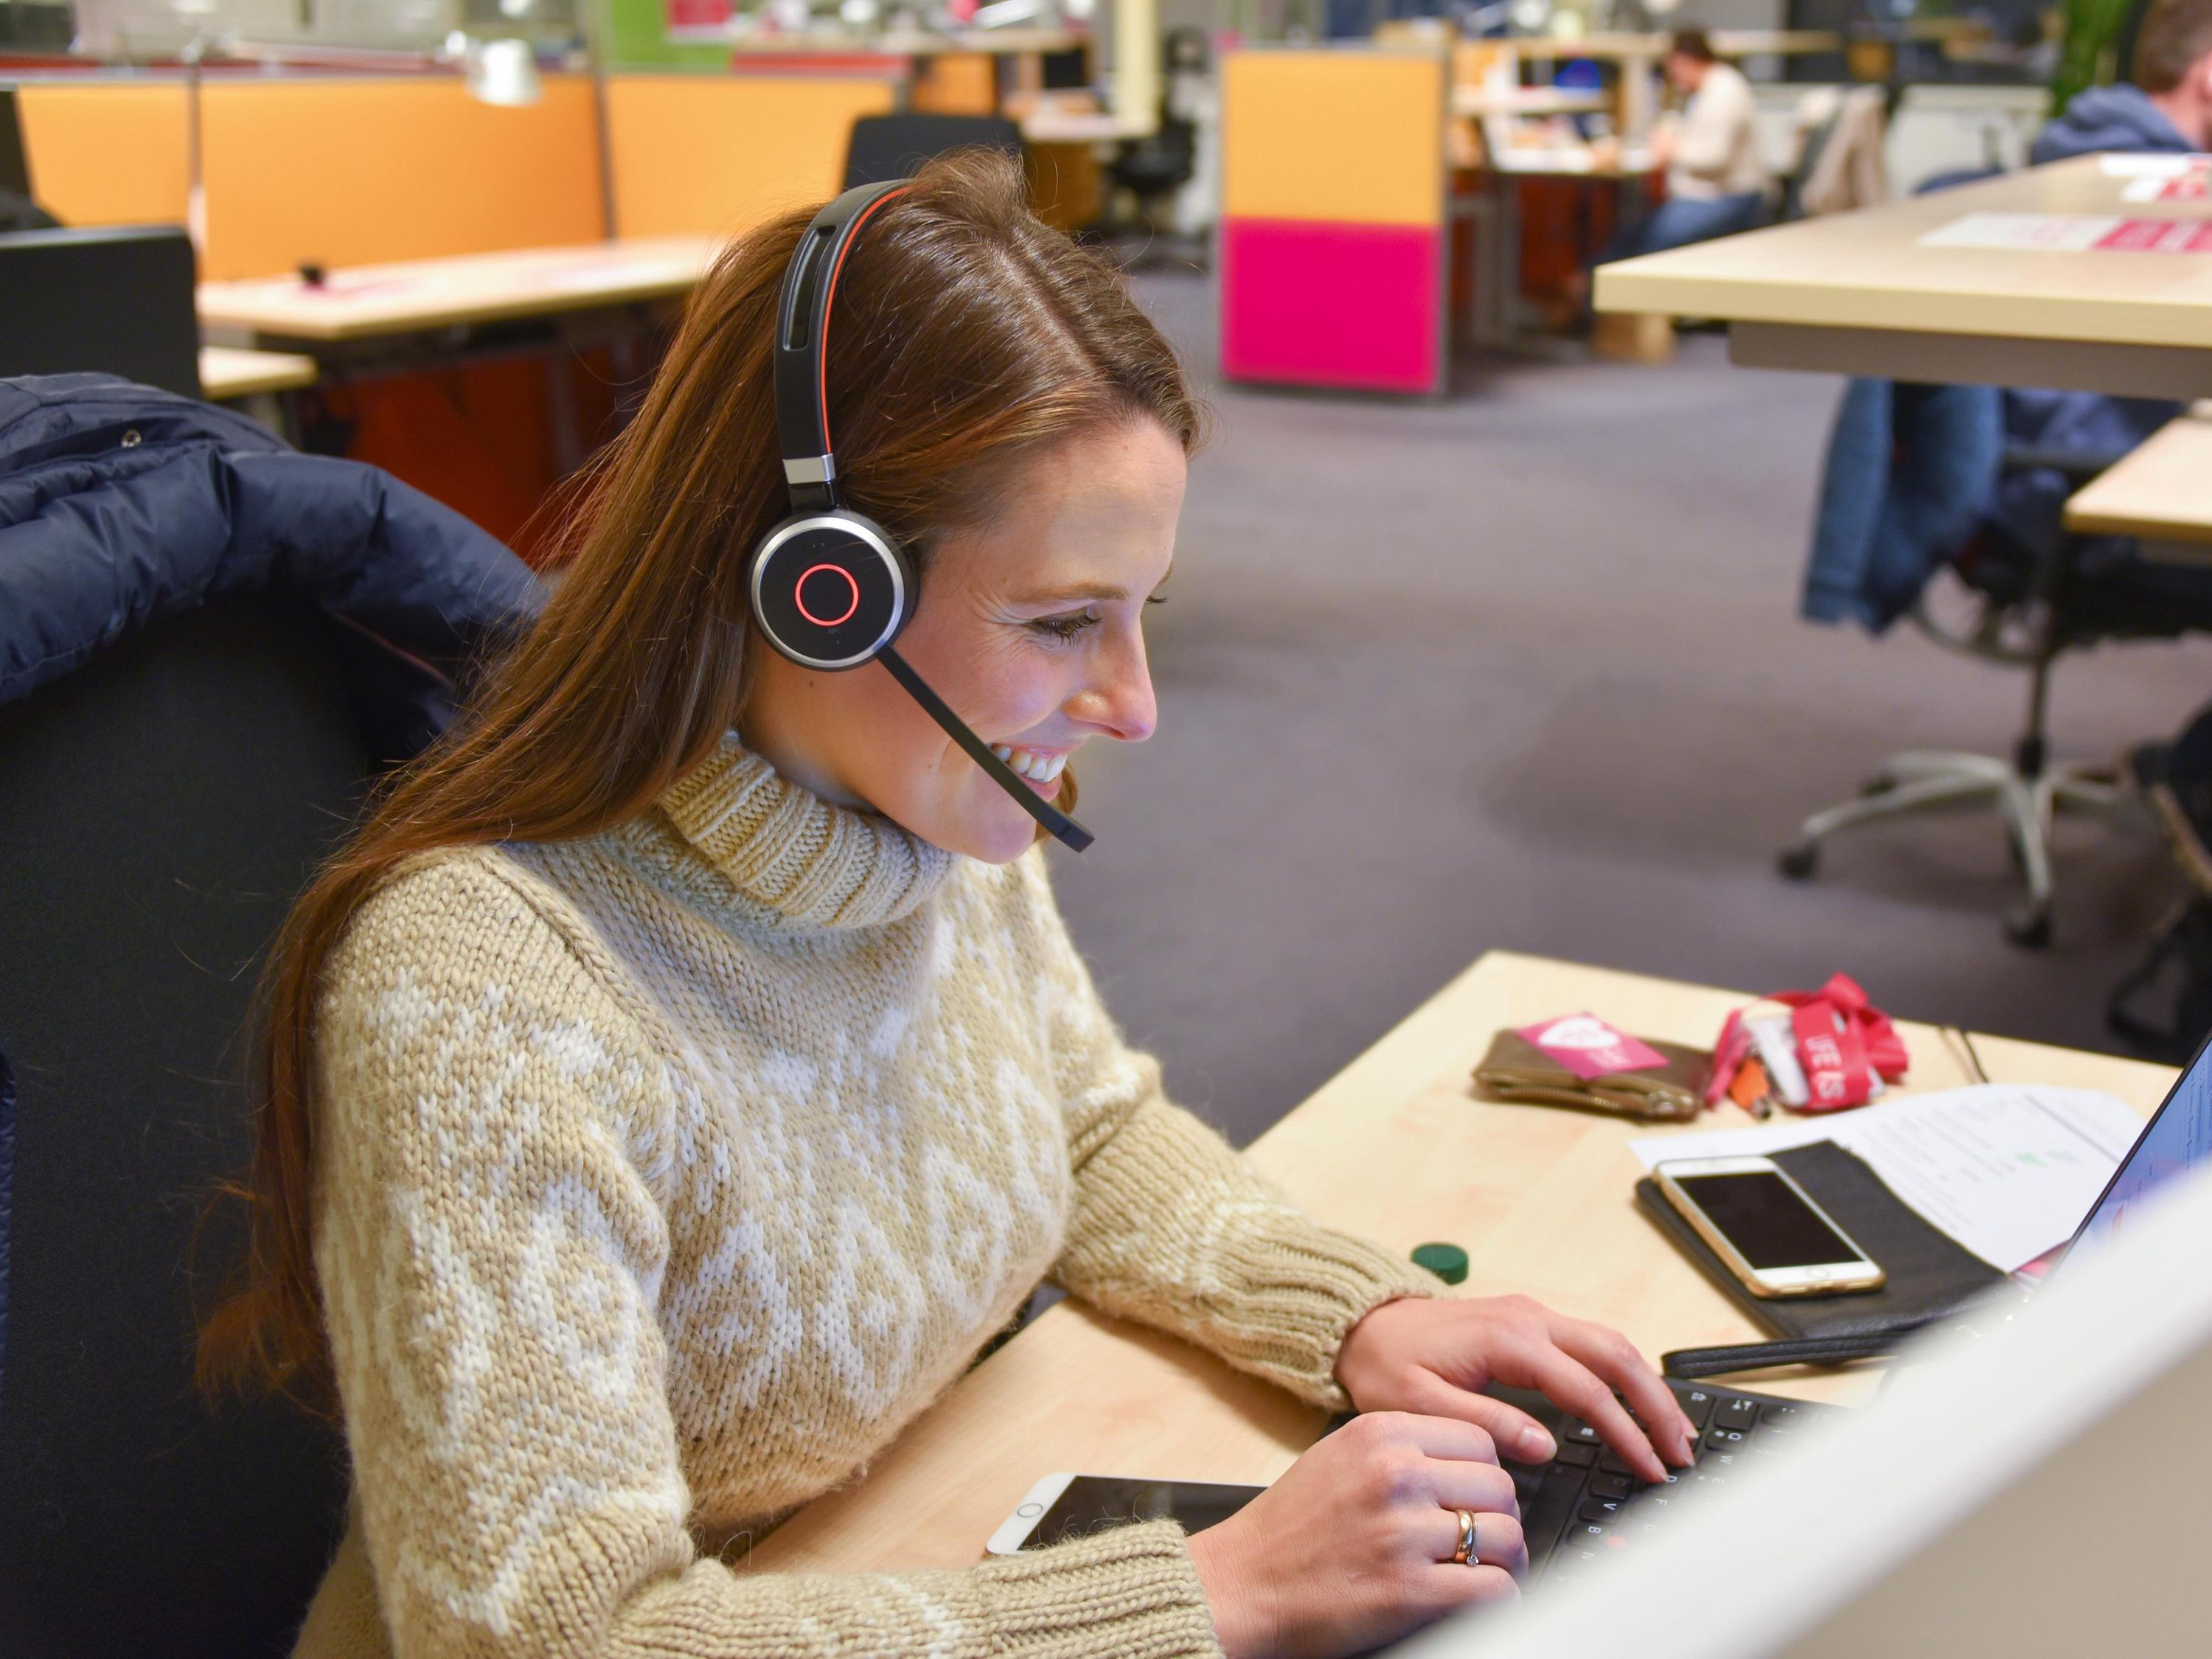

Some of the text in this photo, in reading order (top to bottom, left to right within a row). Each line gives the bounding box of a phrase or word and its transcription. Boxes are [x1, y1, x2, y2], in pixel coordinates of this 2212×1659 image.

[1720, 1455, 1733, 1464] W
[1588, 1526, 1601, 1534] B
[1581, 1551, 1596, 1560] N
